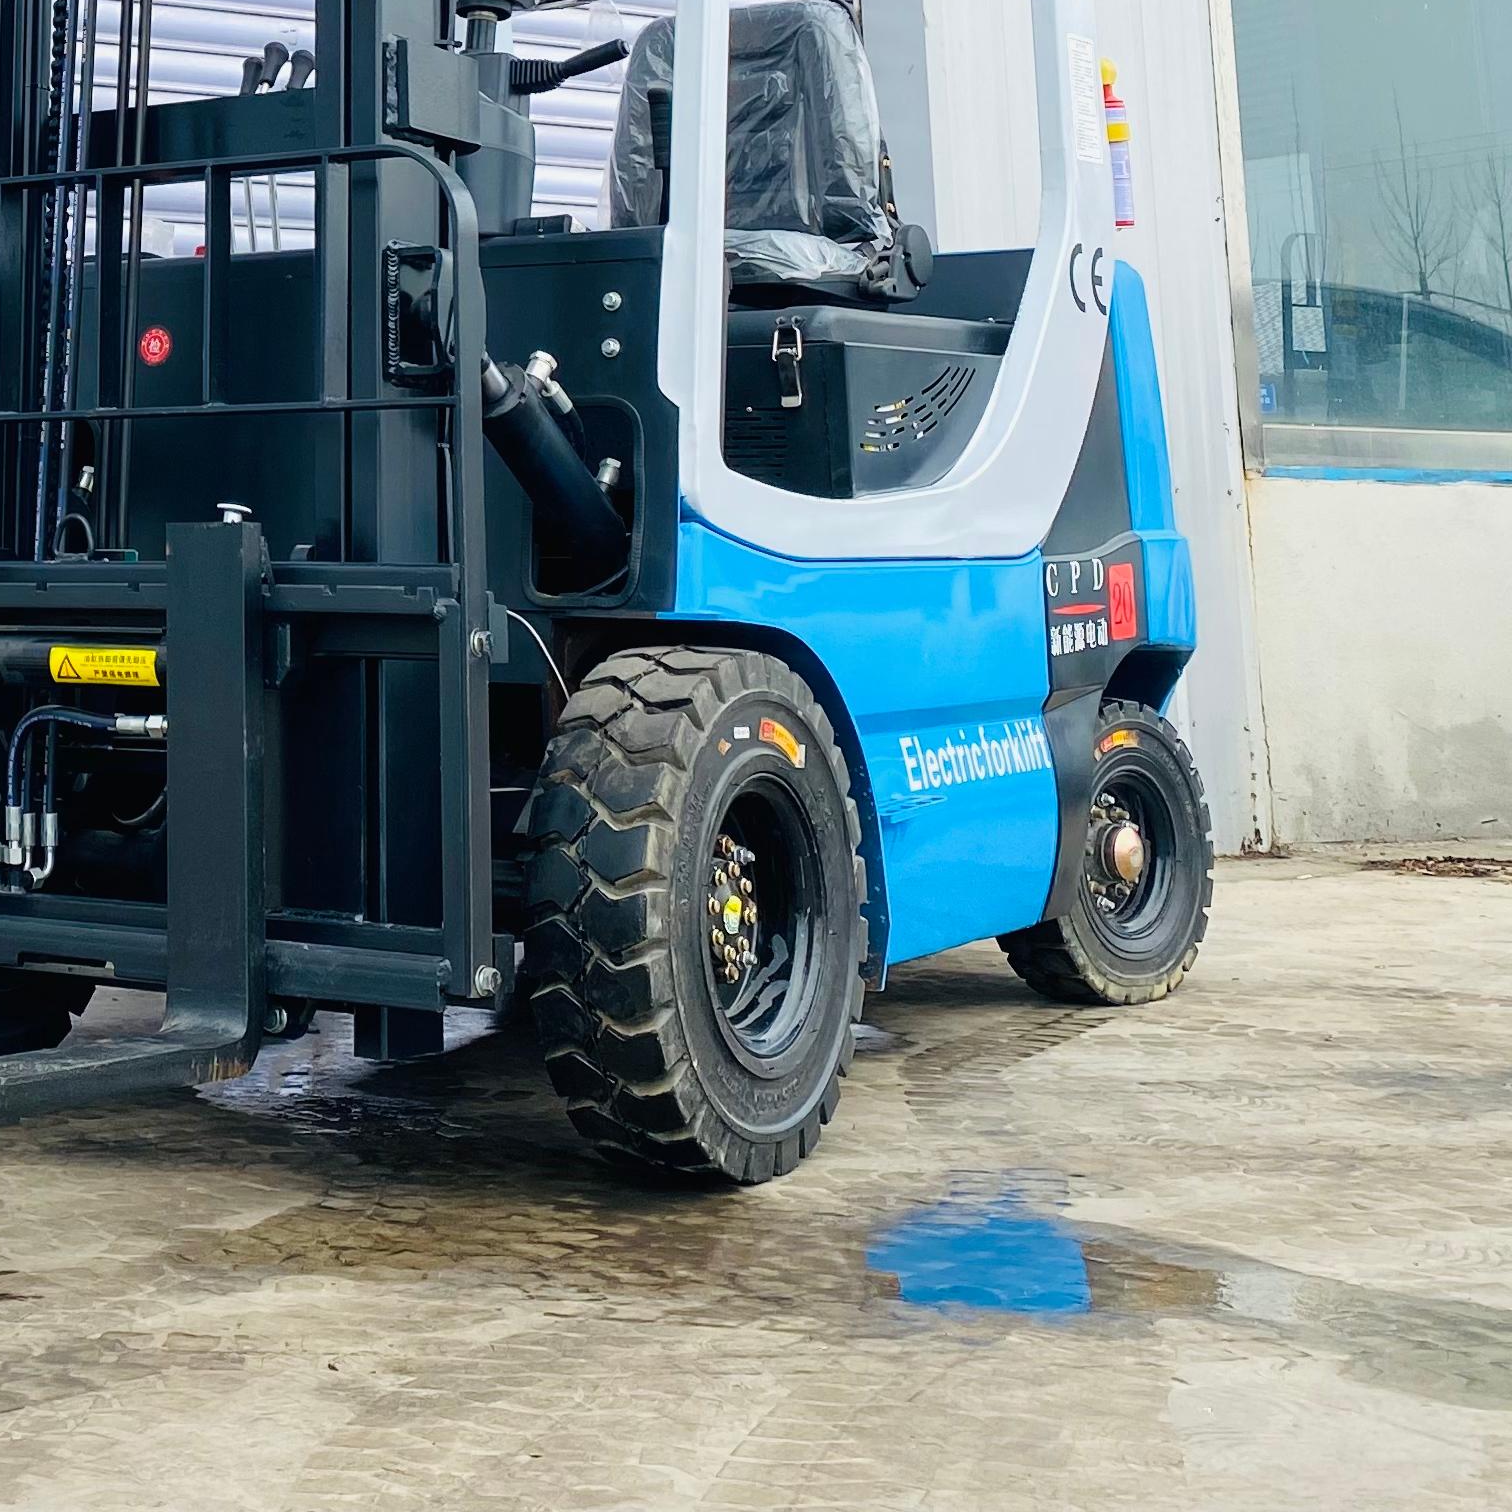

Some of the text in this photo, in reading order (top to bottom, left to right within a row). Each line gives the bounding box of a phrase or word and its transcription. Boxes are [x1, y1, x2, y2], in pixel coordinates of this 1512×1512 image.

[1069, 243, 1107, 316] CE
[1112, 581, 1134, 625] 20
[1050, 617, 1109, 657] 新能源电动
[898, 719, 1053, 793] Electricforklift
